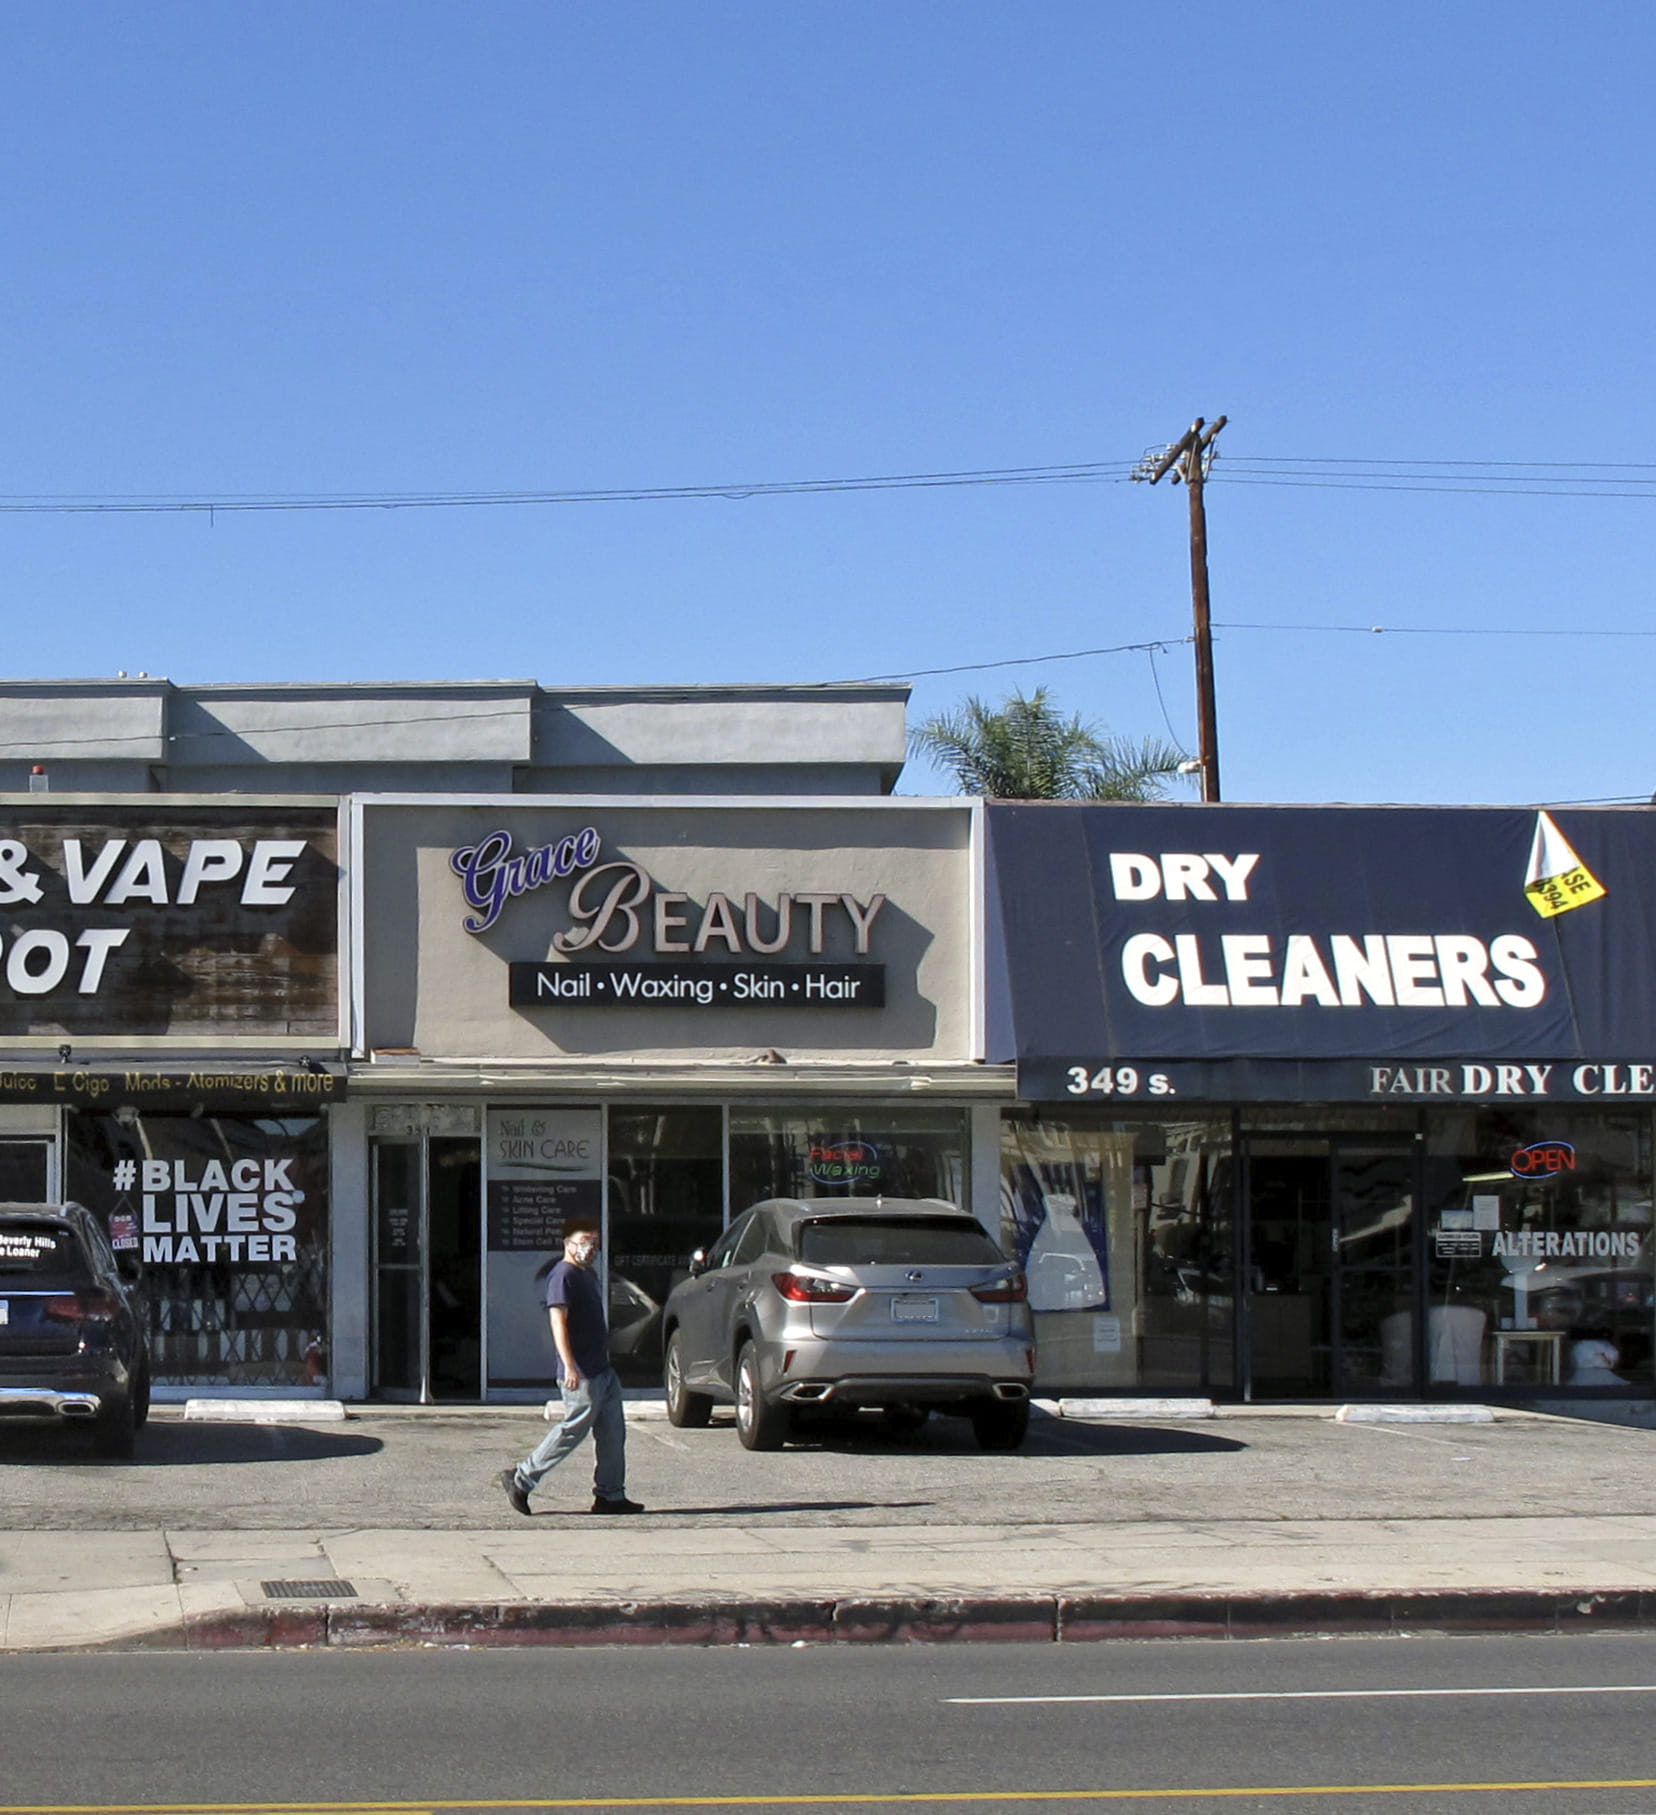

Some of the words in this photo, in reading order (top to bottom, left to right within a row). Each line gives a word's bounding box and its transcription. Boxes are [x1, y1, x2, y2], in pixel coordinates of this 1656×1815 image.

[63, 839, 309, 906] VAPE
[449, 827, 601, 934] Grace
[1109, 852, 1260, 901] DRY
[552, 861, 887, 954] BEAUTY
[1121, 933, 1546, 1008] CLEANERS
[537, 972, 591, 998] Nail
[609, 972, 714, 1004] Waxing
[733, 973, 786, 999] Skin
[805, 974, 861, 999] Hair
[125, 1071, 171, 1092] Mods
[186, 1071, 269, 1092] Atomizers
[274, 1069, 287, 1093] &
[292, 1073, 334, 1092] more
[1066, 1066, 1138, 1095] 349
[1370, 1066, 1453, 1095] FAIR
[1460, 1065, 1552, 1095] DRY
[500, 1118, 525, 1136] Nail
[500, 1139, 535, 1159] SKIN
[540, 1139, 590, 1159] CARE
[809, 1146, 865, 1162] Facial
[1511, 1150, 1576, 1171] OPEN
[112, 1159, 296, 1193] #BLACK
[813, 1163, 881, 1178] Waxing
[143, 1194, 297, 1233] LIVES
[6, 1246, 41, 1259] Loaner
[34, 1236, 57, 1250] Hills
[112, 1238, 139, 1250] CLOSED
[143, 1235, 297, 1263] MATTER
[1491, 1231, 1641, 1257] ALTERATIONS
